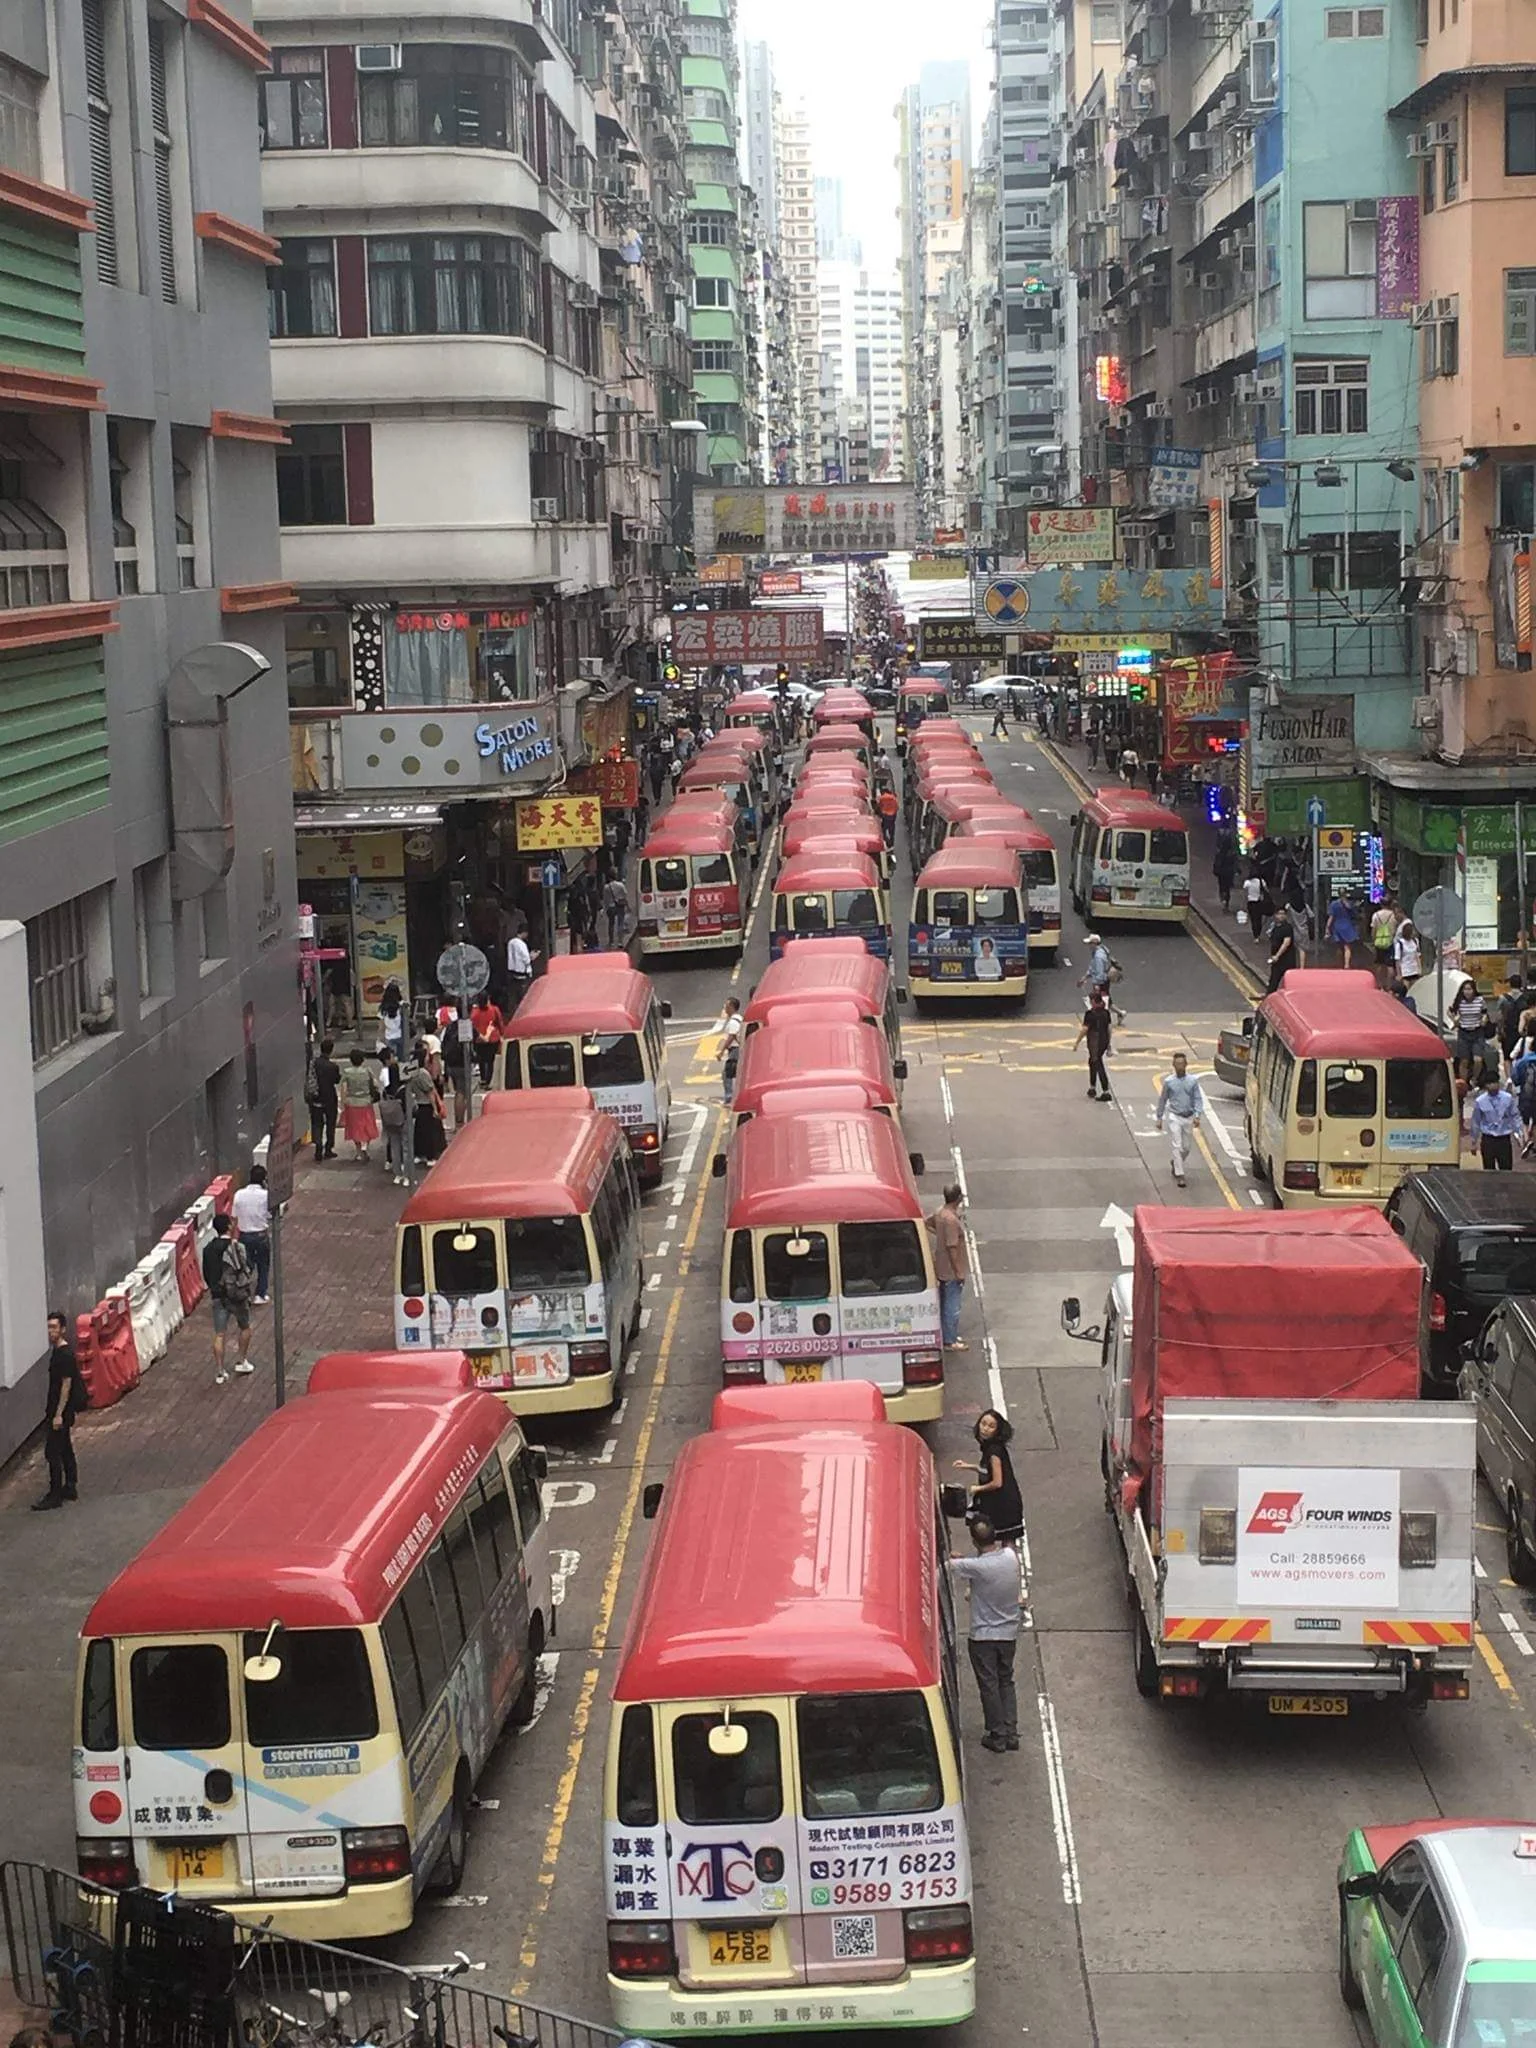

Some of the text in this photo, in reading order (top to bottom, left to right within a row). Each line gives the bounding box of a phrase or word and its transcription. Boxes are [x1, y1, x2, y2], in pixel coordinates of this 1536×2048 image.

[717, 532, 765, 545] Nikon
[675, 613, 818, 649] 宏發燒臘
[476, 716, 538, 756] SALON
[502, 737, 553, 774] MORE
[1282, 746, 1323, 763] SALON
[520, 801, 599, 829] 海天堂
[767, 1339, 839, 1354] 2626 0033
[1256, 1508, 1392, 1521] AGS FOUR WINDS
[1250, 1568, 1386, 1580] www.agsmovers.com
[1271, 1700, 1345, 1712] UM 4505
[808, 1819, 955, 1843] 現代試驗顧問有限公司
[612, 1838, 655, 1857] 專業
[842, 1843, 873, 1851] Testing
[874, 1839, 923, 1850] Consultants
[925, 1836, 955, 1845] Limited
[185, 1863, 204, 1877] 14
[832, 1850, 956, 1879] 3171 6823
[614, 1864, 657, 1884] 漏水
[833, 1877, 958, 1905] 9589 3153
[615, 1890, 659, 1911] 調查
[726, 1931, 756, 1946] FS
[713, 1945, 769, 1963] 4782
